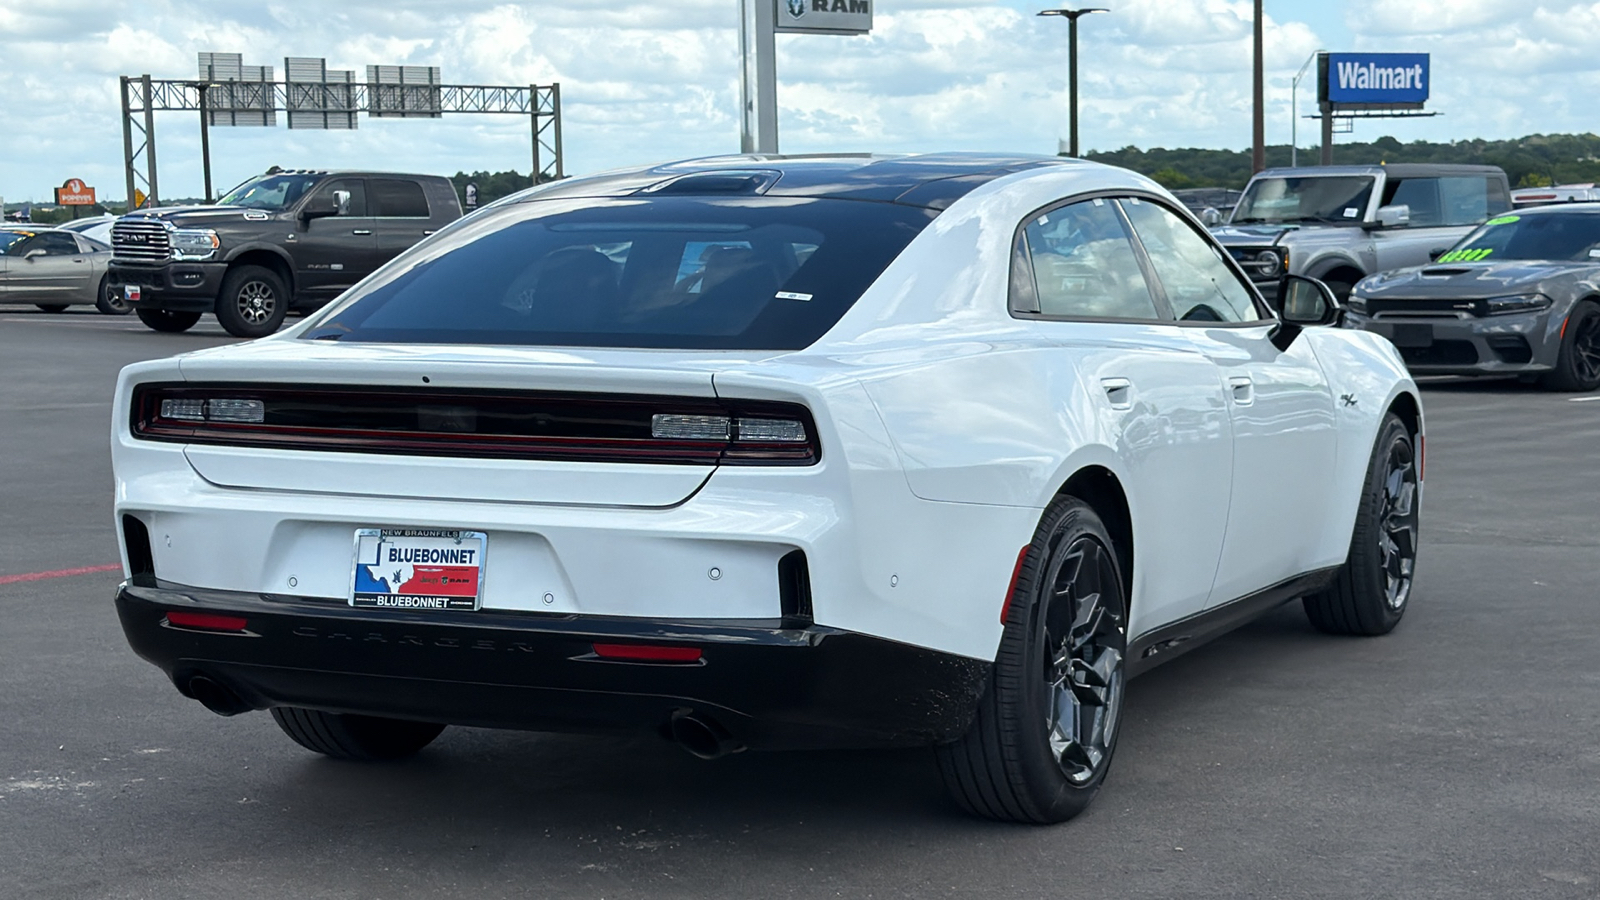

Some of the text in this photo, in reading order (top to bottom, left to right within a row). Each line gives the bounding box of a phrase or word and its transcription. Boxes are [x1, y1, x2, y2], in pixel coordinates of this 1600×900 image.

[812, 0, 868, 14] RAM
[1337, 61, 1423, 90] Walmart
[61, 194, 92, 202] POPEYES
[405, 530, 458, 538] BRAUNFELS
[389, 548, 475, 564] BLUEBONNET
[377, 596, 449, 608] BLUEBONNET
[293, 627, 534, 653] CHARGER
